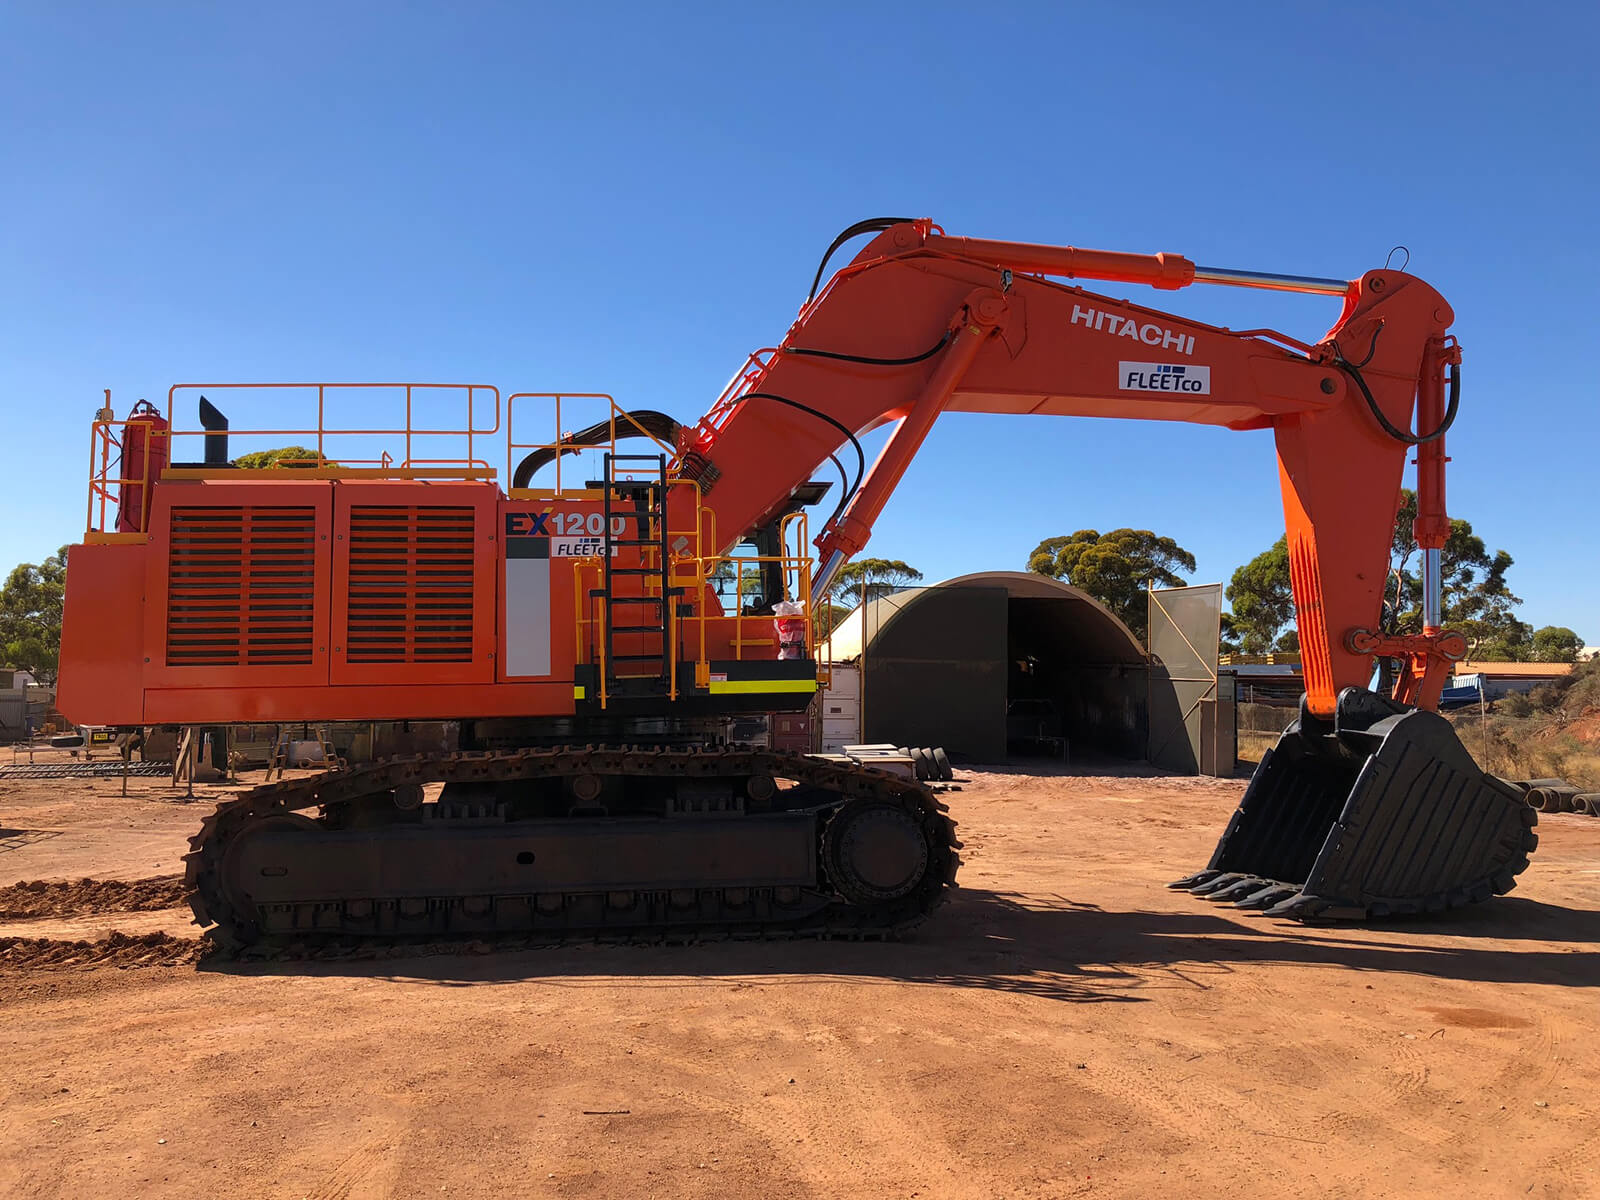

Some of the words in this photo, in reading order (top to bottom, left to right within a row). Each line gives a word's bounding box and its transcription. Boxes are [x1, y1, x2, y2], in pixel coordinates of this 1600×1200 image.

[1070, 304, 1195, 355] HITACHI
[1126, 371, 1203, 392] FLEETco
[557, 543, 612, 556] FLEETc
